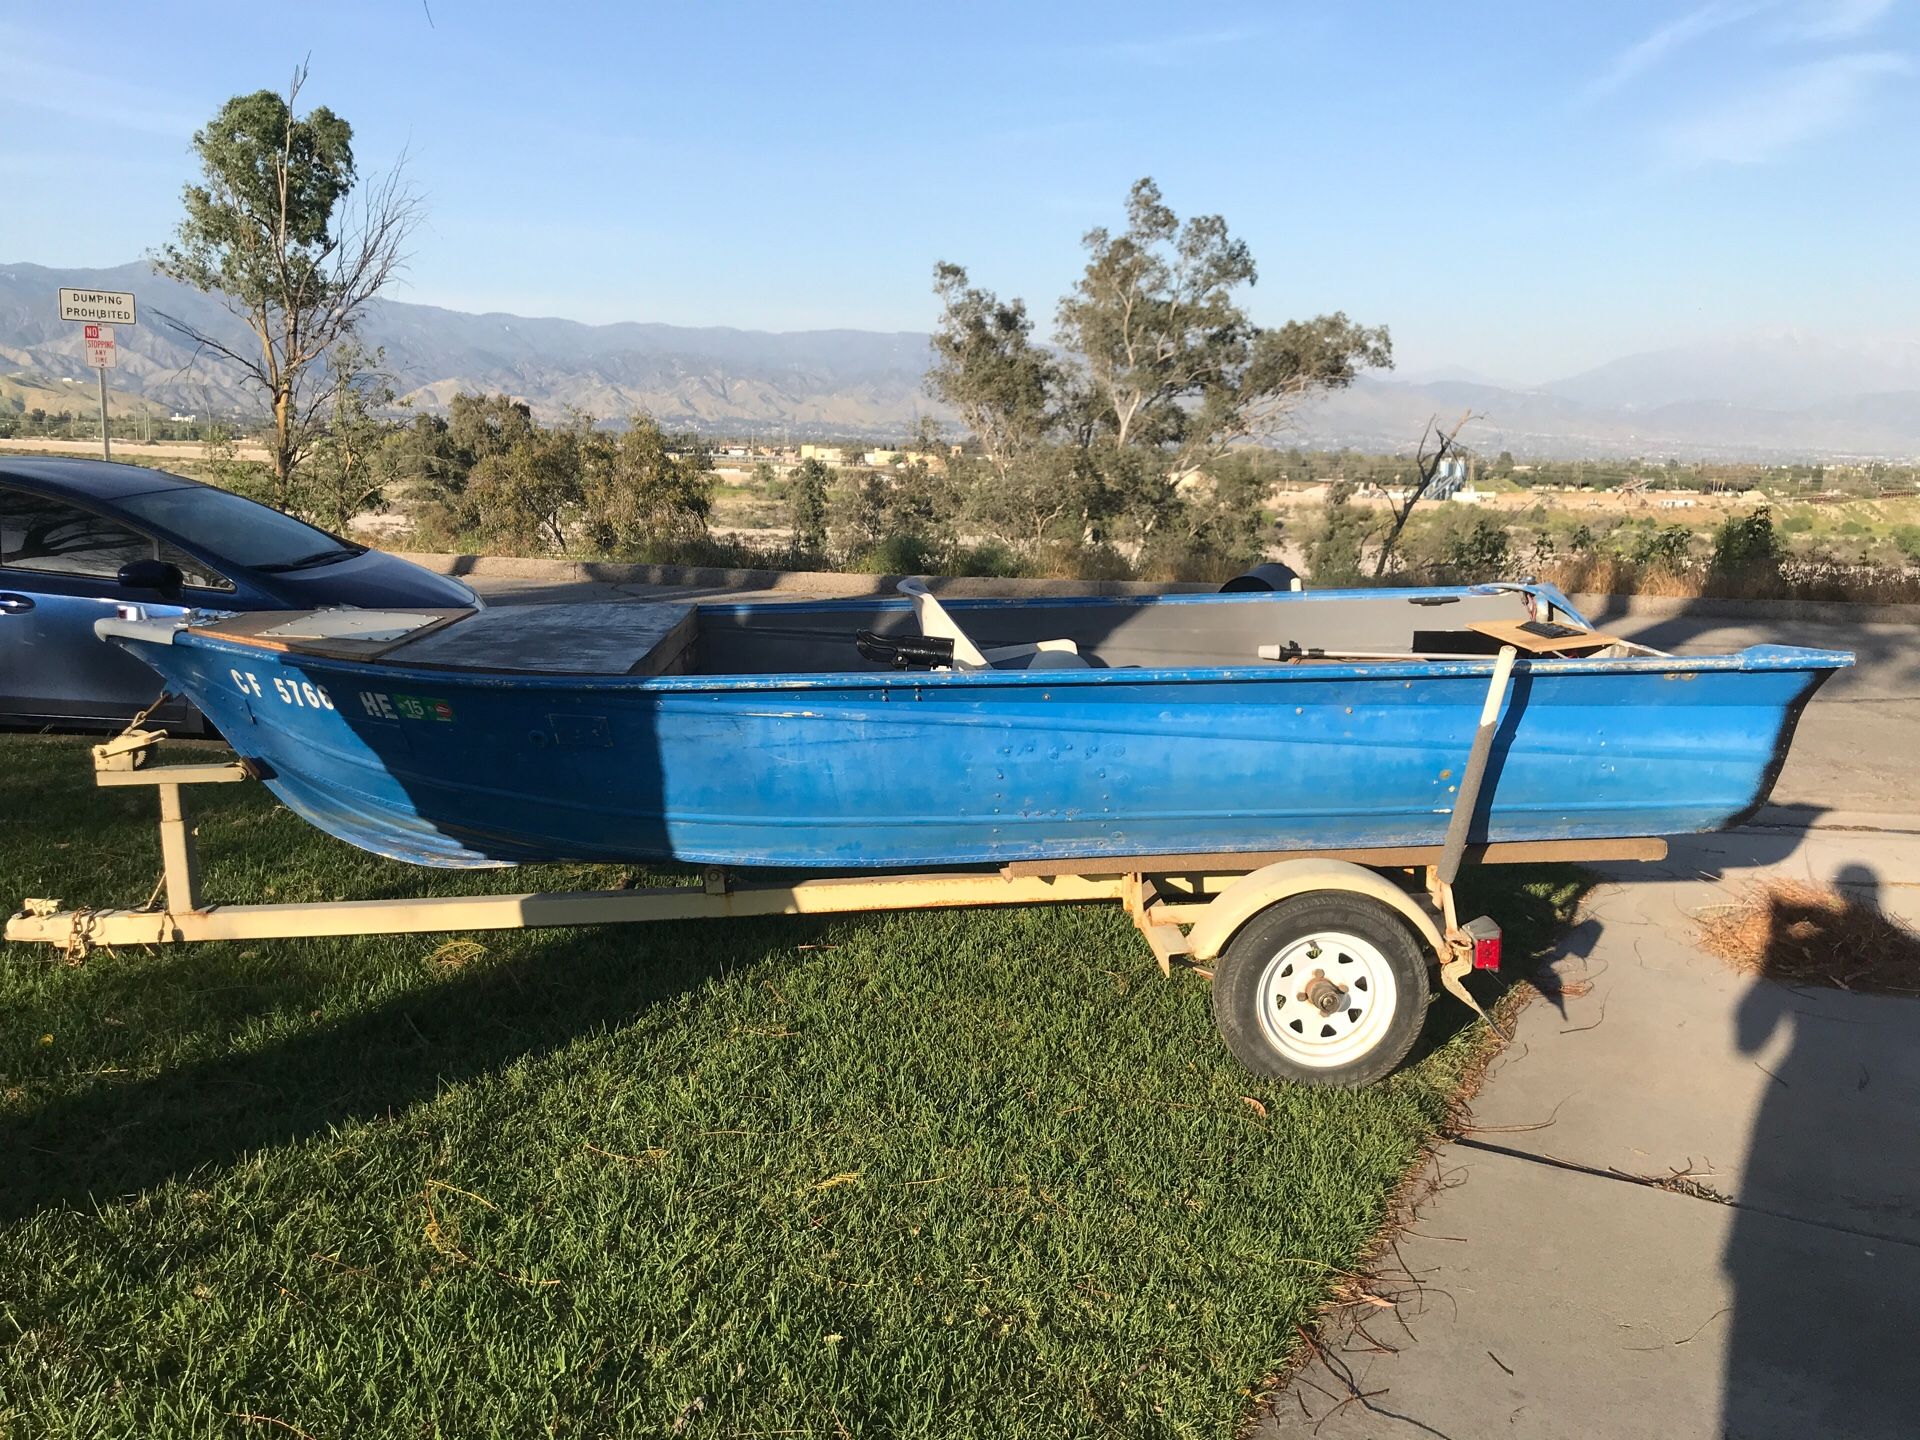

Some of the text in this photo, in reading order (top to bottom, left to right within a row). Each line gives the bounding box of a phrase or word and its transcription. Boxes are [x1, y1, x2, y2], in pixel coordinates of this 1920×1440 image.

[73, 293, 122, 305] DUMPING
[66, 307, 130, 320] PROHIBITED
[86, 327, 97, 337] NO
[87, 340, 113, 349] STOPPING
[230, 669, 399, 719] CF 5766 HE
